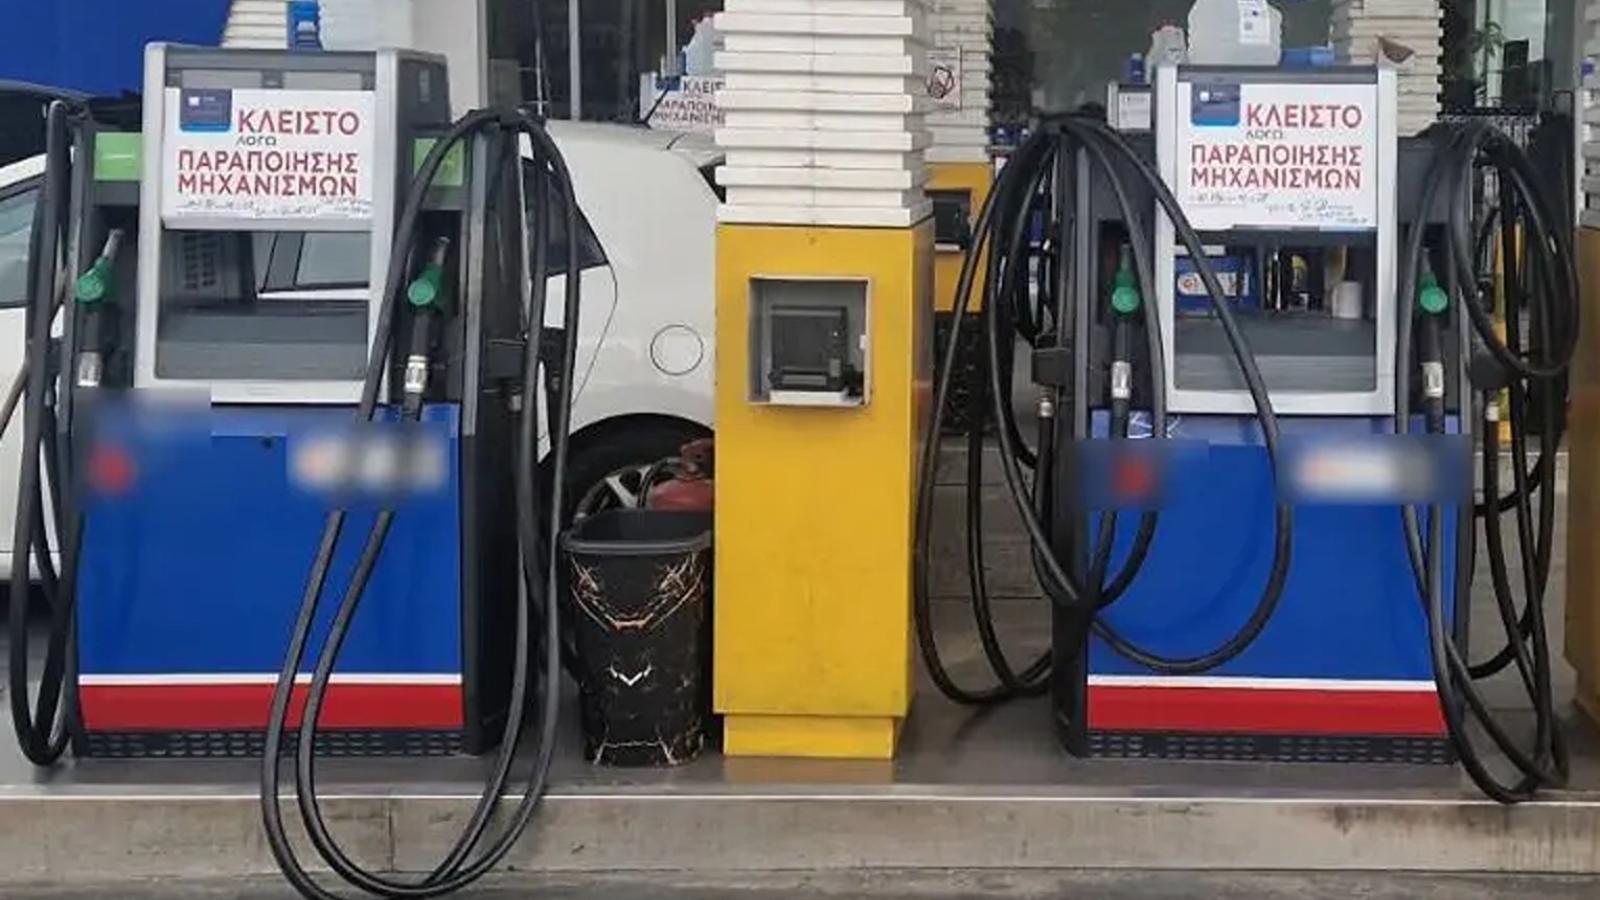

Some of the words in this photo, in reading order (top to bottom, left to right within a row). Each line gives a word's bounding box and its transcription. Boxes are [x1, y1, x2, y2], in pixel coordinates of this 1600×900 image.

[238, 110, 360, 135] ΚΛΕΙΣΤΟ
[1247, 104, 1362, 128] ΚΛΕΙΣΤΟ
[178, 150, 359, 173] ΠΑΡΑΠΟΙΗΣΗΣ
[1191, 145, 1362, 166] ΠΑΡΑΠΟΙΗΣΗΣ
[178, 174, 358, 196] ΜΗΧΑΝΙΣΜΩΝ
[1191, 168, 1361, 189] ΜΗΧΑΝΙΣΜΩΝ
